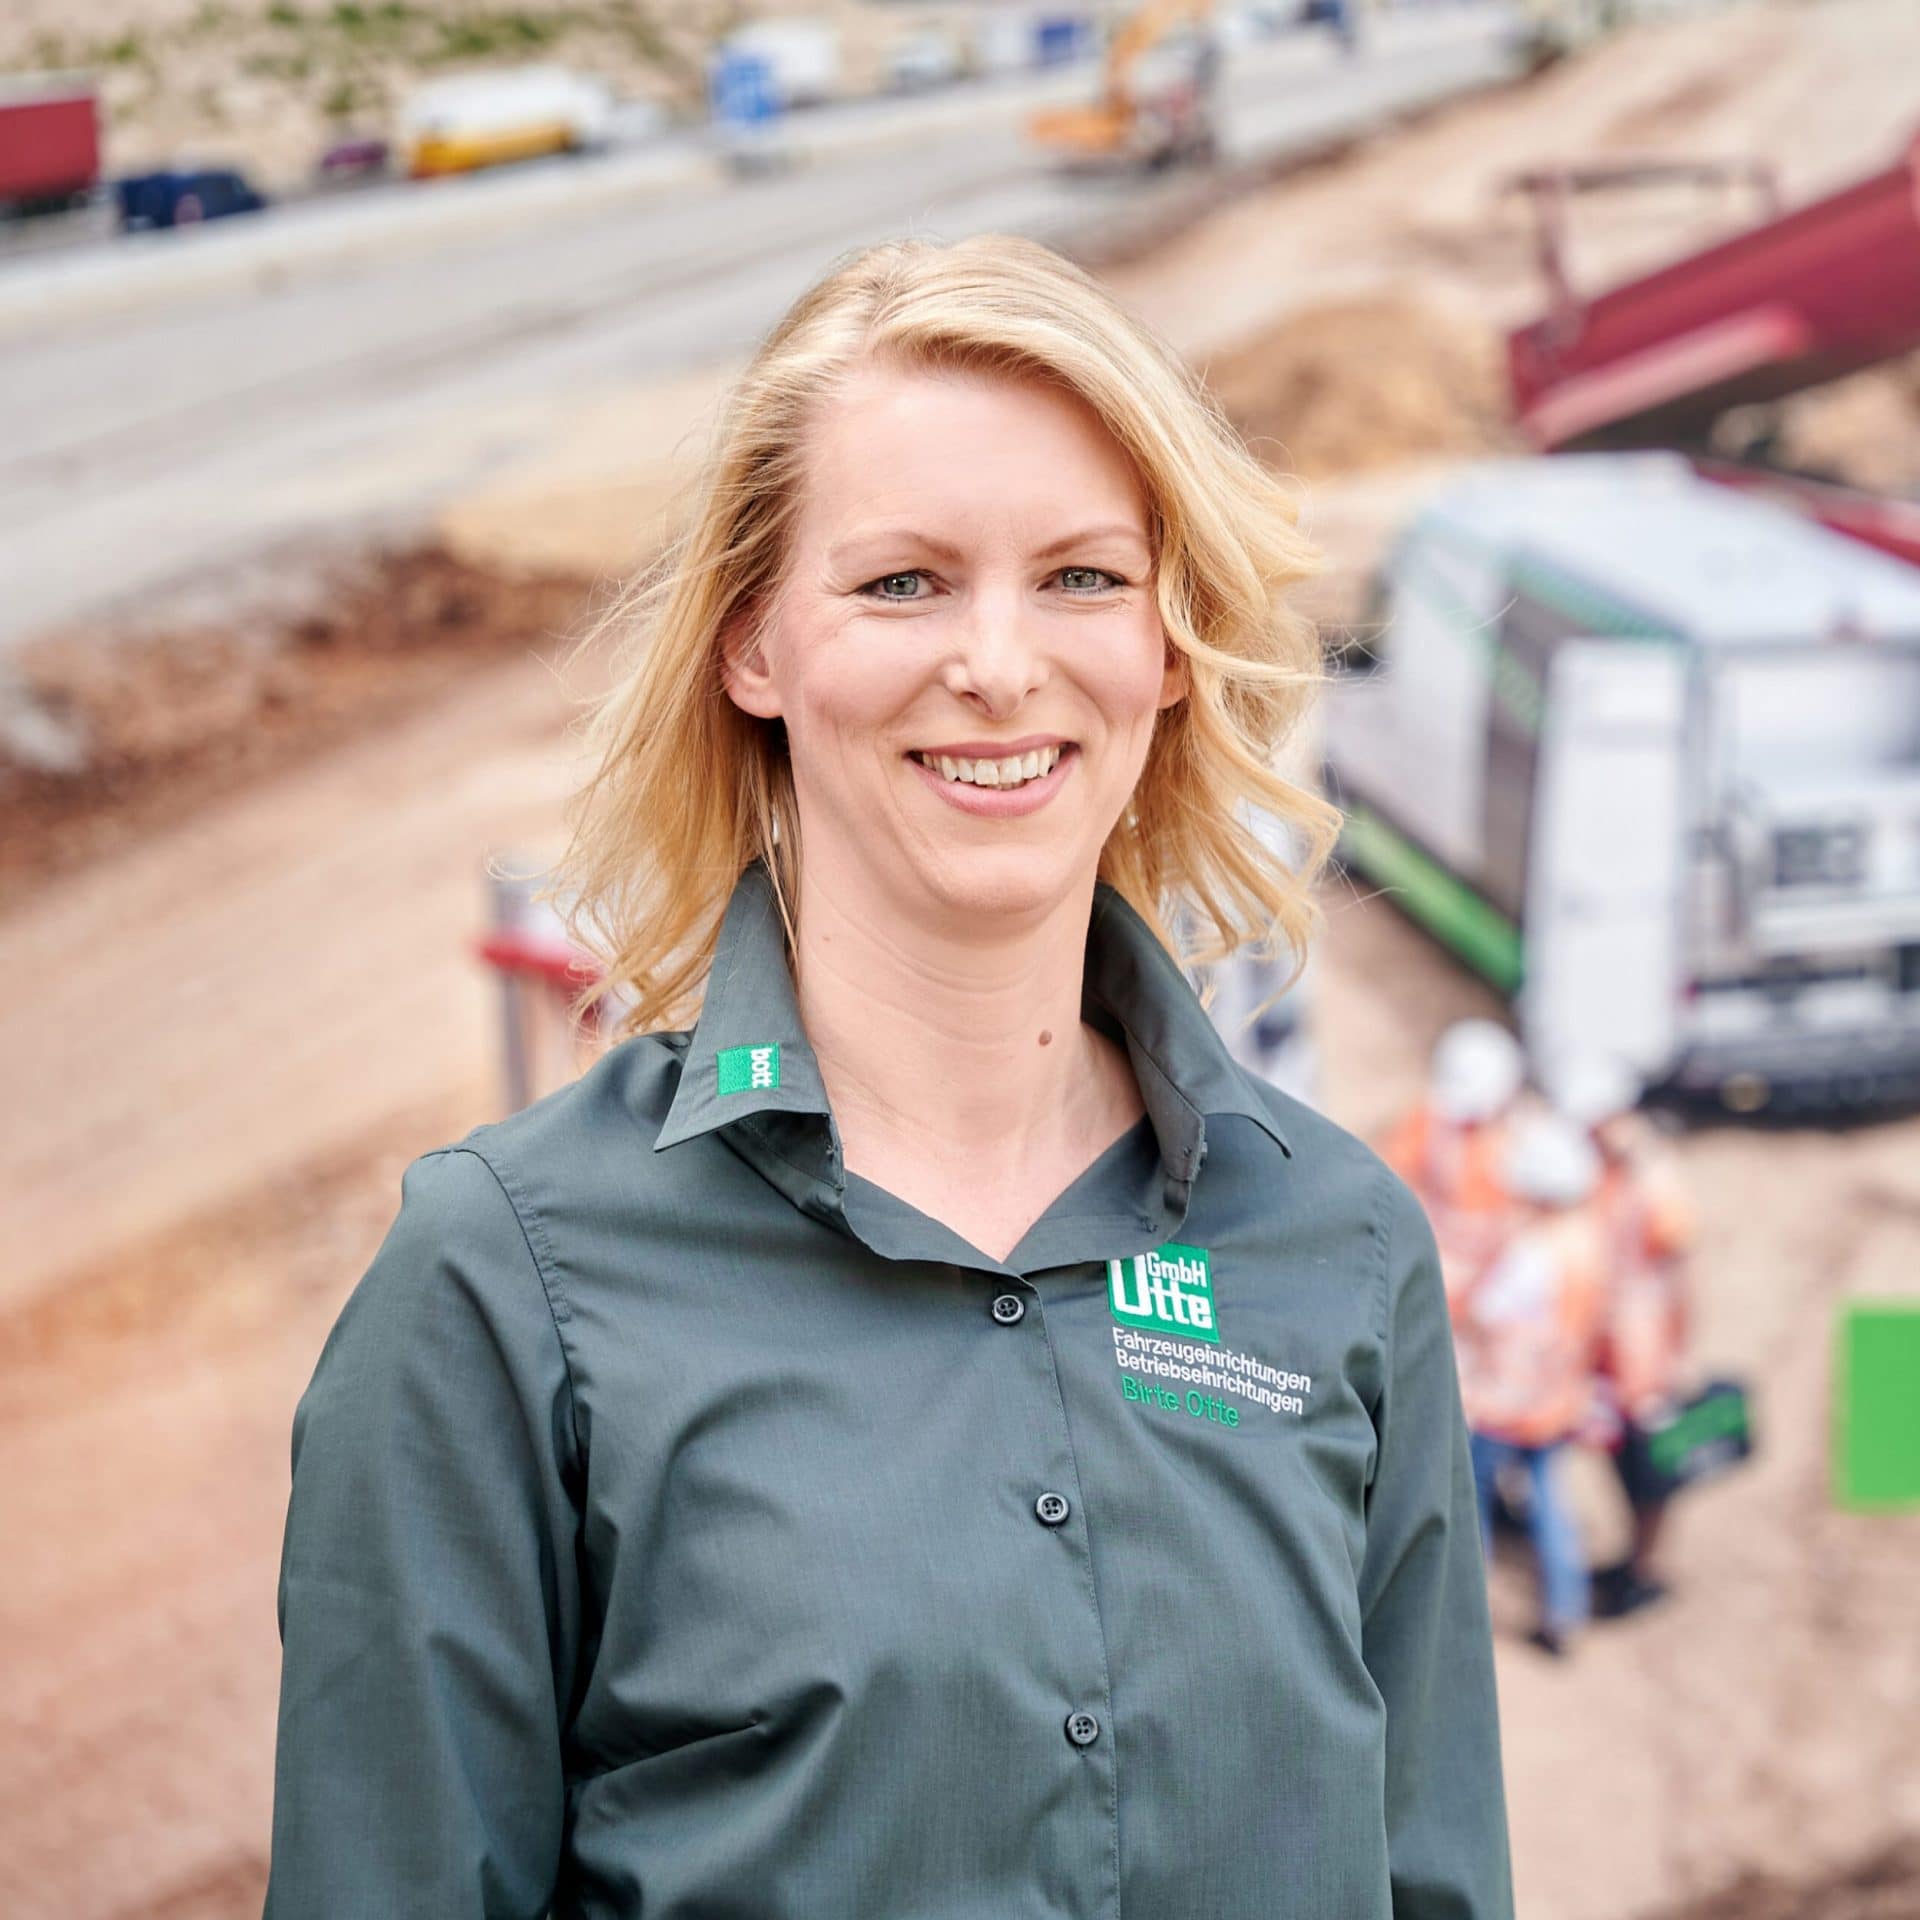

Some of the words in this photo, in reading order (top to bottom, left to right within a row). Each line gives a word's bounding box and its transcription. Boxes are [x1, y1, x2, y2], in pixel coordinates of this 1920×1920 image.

[750, 1047, 773, 1089] bott
[1146, 1252, 1208, 1288] GmbH
[1112, 1326, 1312, 1393] Fahrzeugeinrichtungen
[1115, 1348, 1304, 1415] Betriebseinrichtungen
[1121, 1374, 1180, 1412] Birte
[1186, 1389, 1241, 1428] Otte
